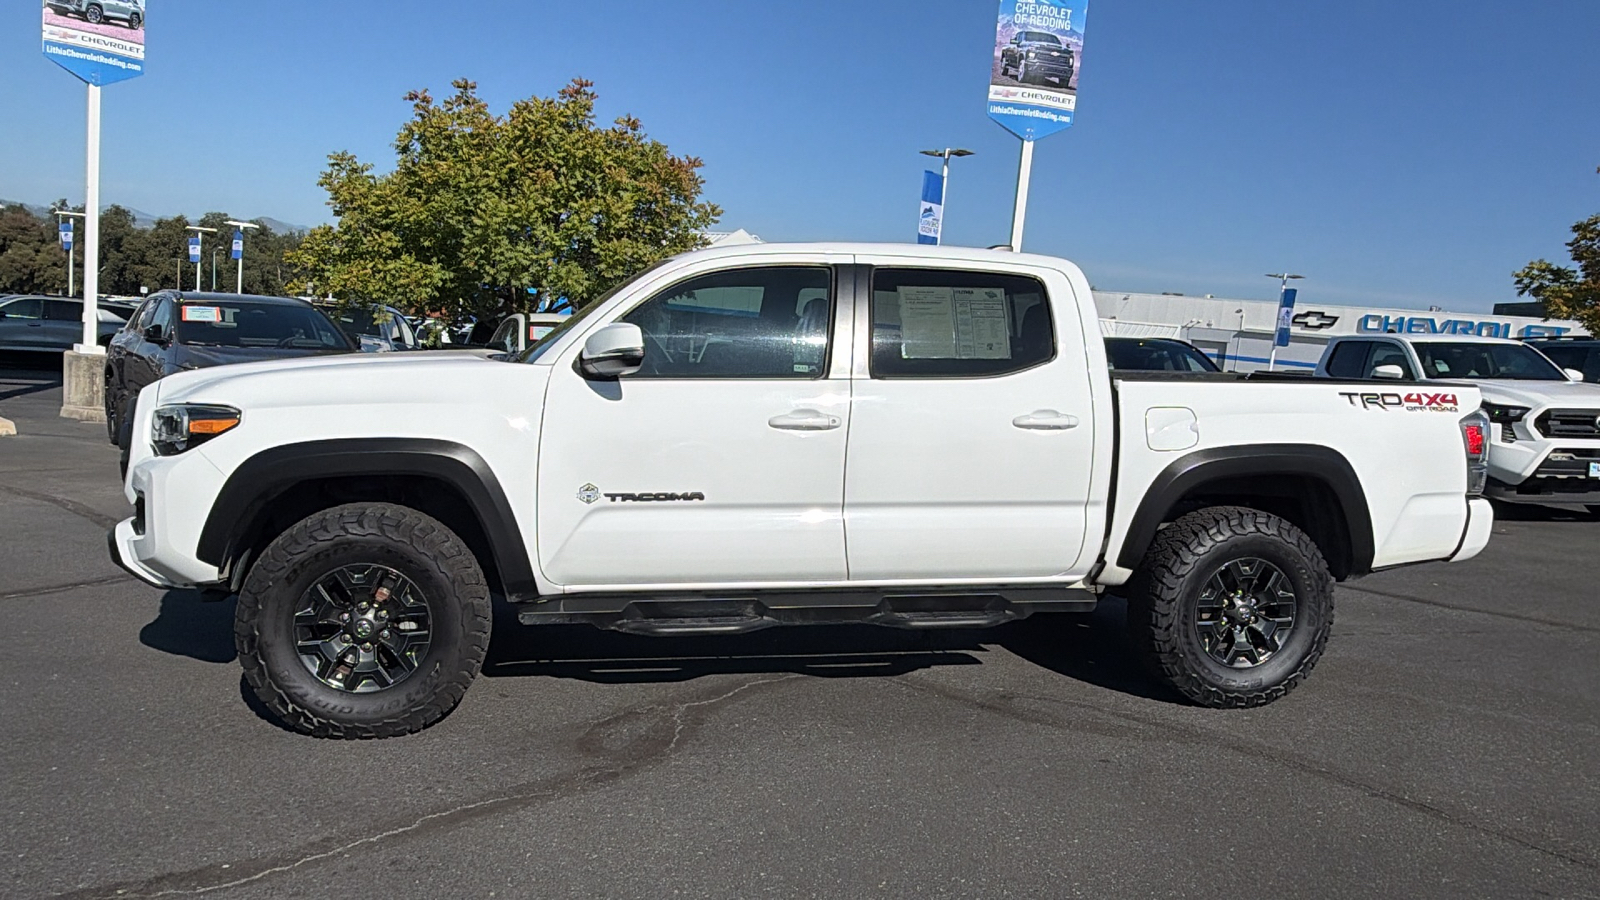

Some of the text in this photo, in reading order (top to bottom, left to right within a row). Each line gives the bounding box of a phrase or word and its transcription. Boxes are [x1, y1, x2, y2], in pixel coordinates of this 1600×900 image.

[1015, 3, 1073, 20] CHEVROLET
[1014, 13, 1071, 31] OF REDDING
[81, 35, 141, 54] CHEVROLET
[46, 45, 142, 71] LithiaChevroletRedding.com
[1021, 91, 1073, 105] CHEVROLET
[989, 105, 1071, 122] LithiaChevroletRedding.com
[1357, 314, 1572, 338] CHEVROLET
[603, 491, 705, 502] TACOMA
